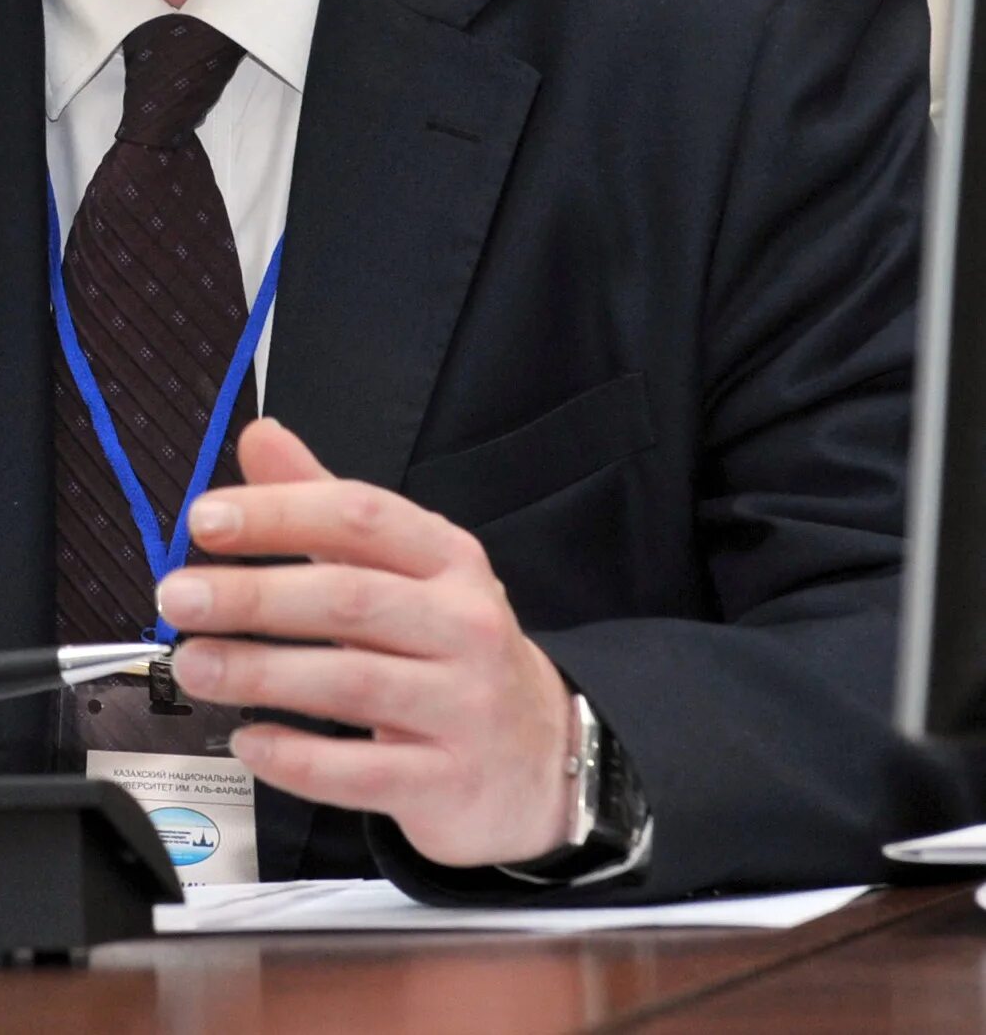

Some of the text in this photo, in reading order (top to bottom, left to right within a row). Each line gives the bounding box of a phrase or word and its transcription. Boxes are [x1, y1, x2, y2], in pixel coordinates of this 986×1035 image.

[113, 769, 246, 783] КАЗАХСКИЙ НАЦИОНАЛЬНЫЙ
[118, 781, 174, 792] ИВЕРСИТЕТ
[194, 785, 252, 796] АЛЬ-ФАРАБИ
